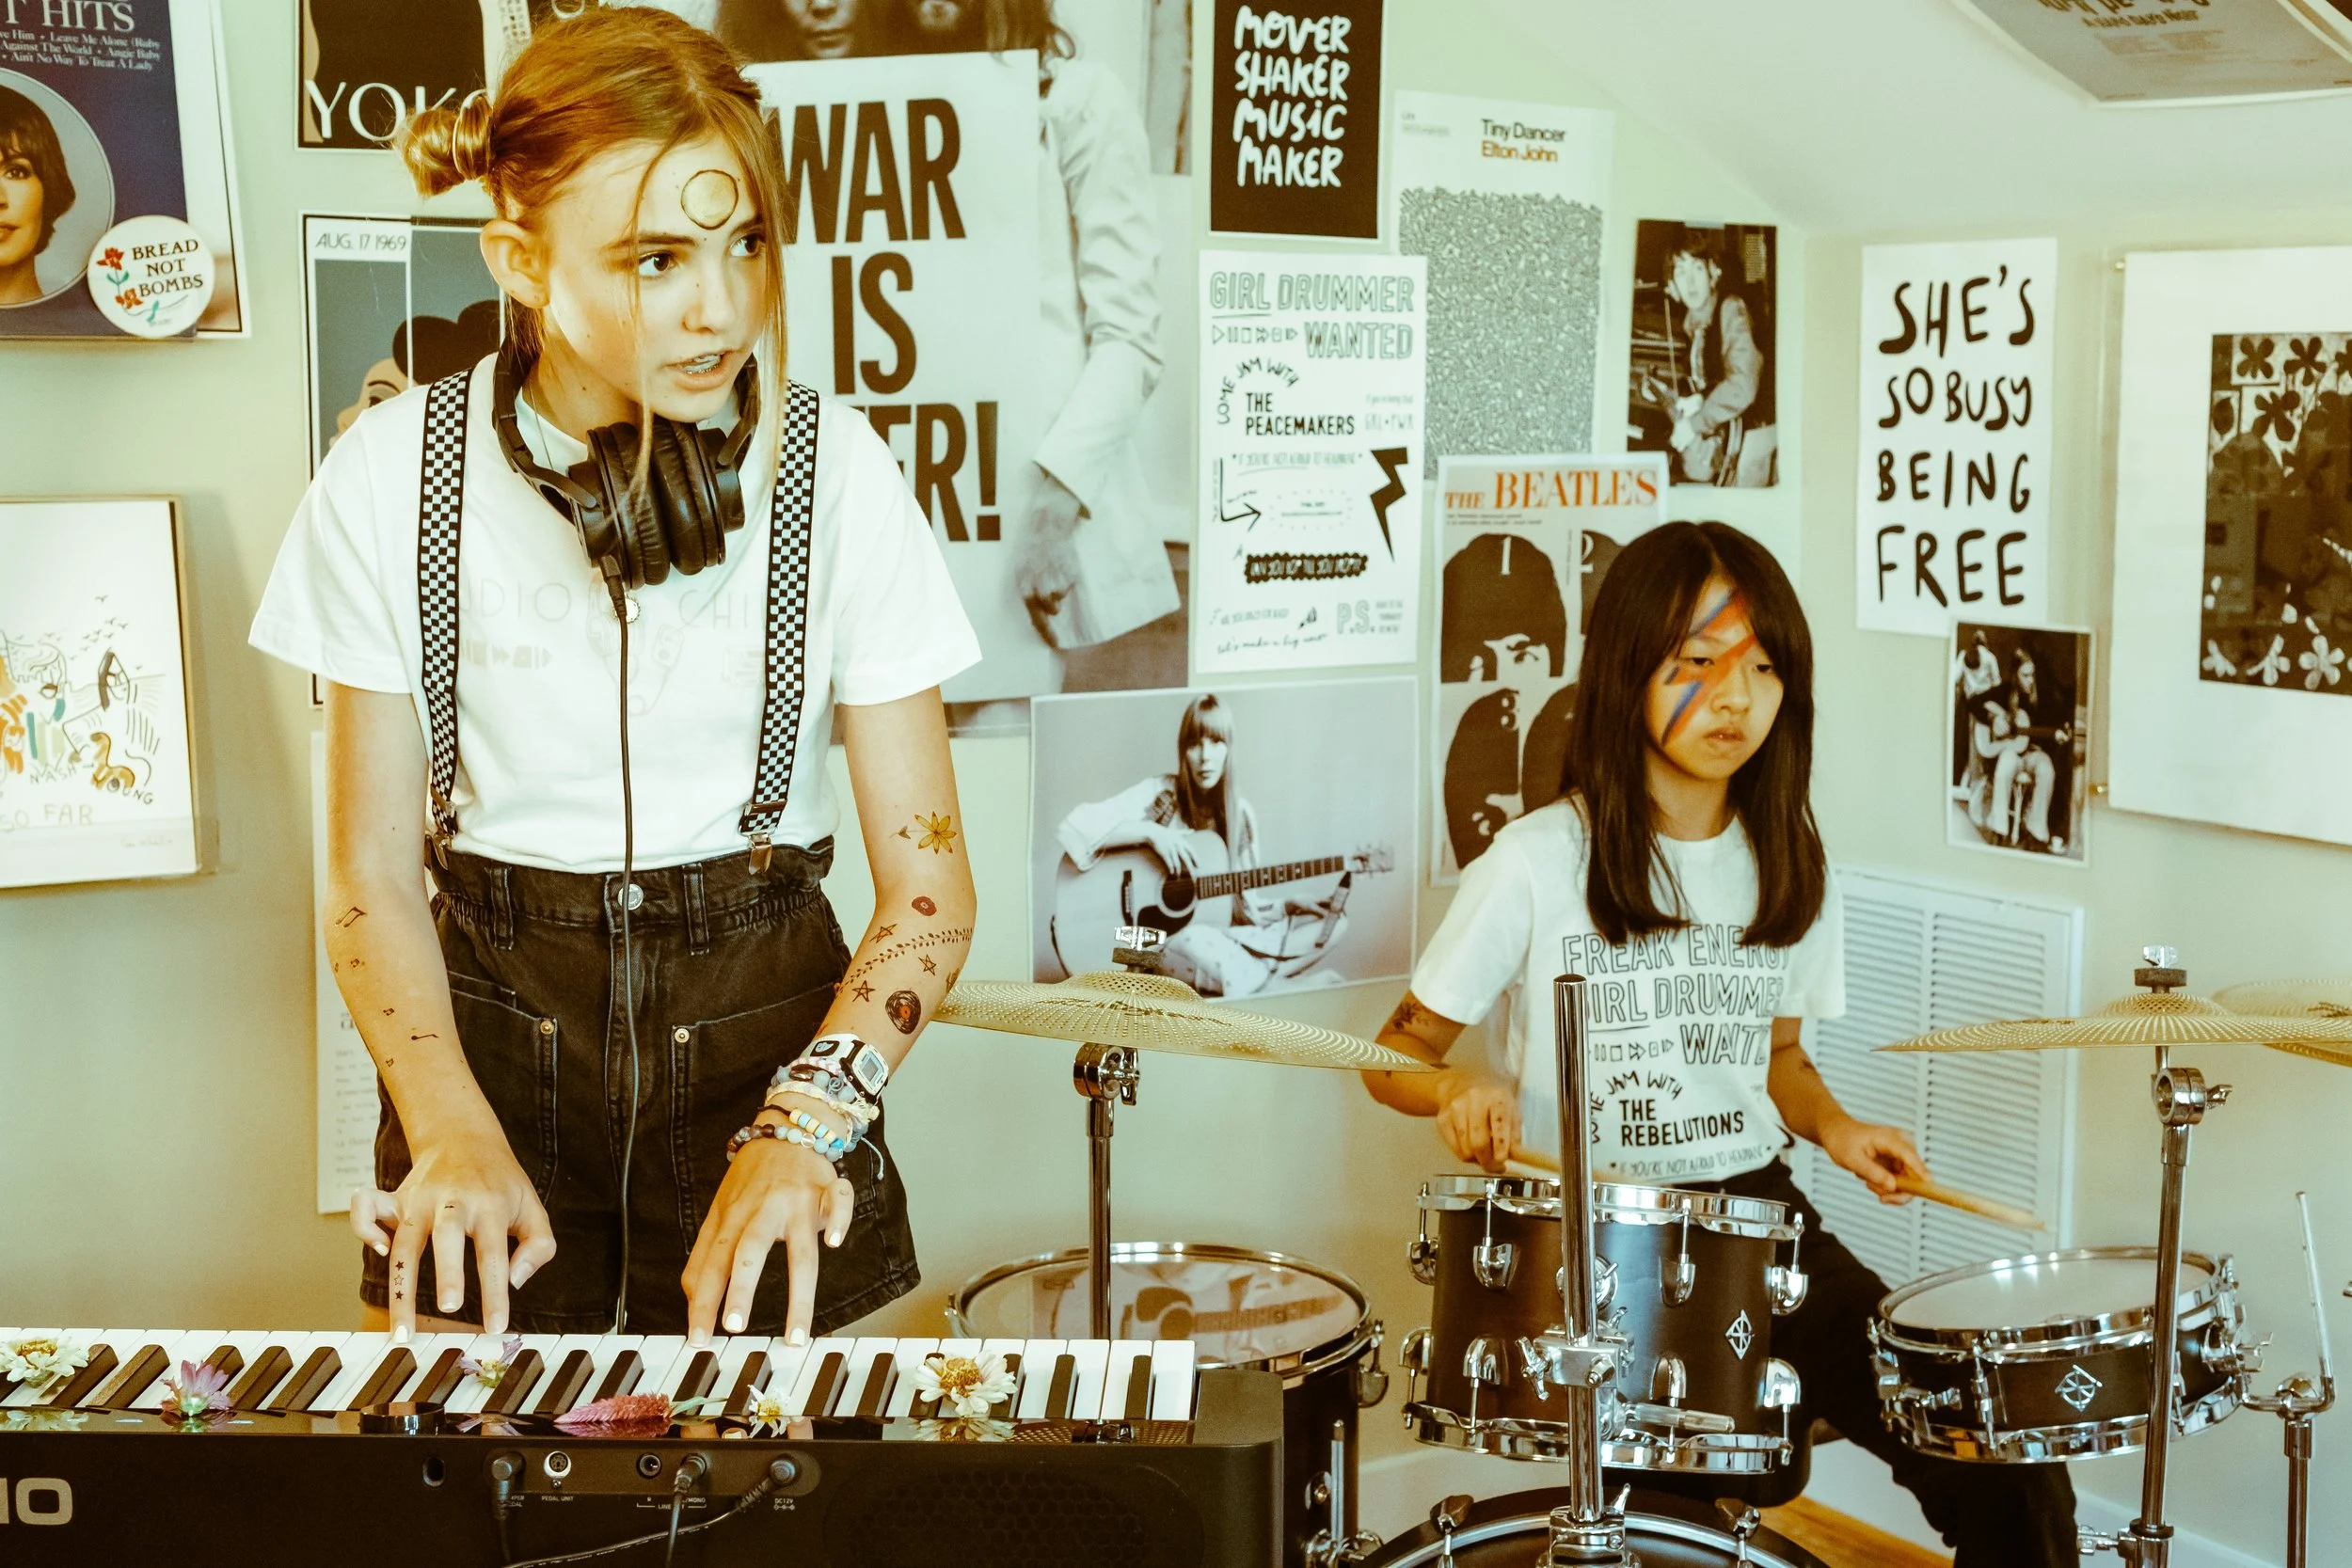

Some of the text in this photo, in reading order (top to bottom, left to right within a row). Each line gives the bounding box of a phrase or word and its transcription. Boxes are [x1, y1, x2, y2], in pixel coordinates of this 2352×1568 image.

[41, 0, 135, 32] HITS
[1234, 5, 1352, 55] MOVER
[1234, 50, 1351, 102] SHAKER
[305, 79, 486, 142] YOK
[1481, 118, 1511, 141] Tiny
[766, 98, 966, 245] WAR
[1236, 135, 1344, 188] MAKER
[1521, 143, 1560, 162] John
[132, 239, 199, 261] BREAD
[315, 232, 353, 250] AUG.
[374, 234, 407, 251] 1969
[138, 275, 204, 297] BOMBS
[146, 258, 186, 277] NOT
[1209, 271, 1414, 312] GIRL DRUMMER
[1879, 264, 2035, 358] SHE'S
[832, 251, 916, 395] IS
[1304, 321, 1414, 359] WANTED
[1245, 391, 1273, 413] THE
[1879, 366, 2032, 431] SO BUSY
[1246, 415, 1355, 436] PEACEMAKERS
[1445, 468, 1658, 509] THE BEATLES
[1877, 450, 2030, 514] BEING
[1877, 525, 2027, 608] FREE
[44, 803, 93, 827] FAR
[1563, 926, 1674, 975] FREAK
[1587, 980, 1648, 1023] IRL
[1605, 1069, 1640, 1095] JAM
[1646, 1069, 1683, 1101] WITH
[1619, 1099, 1656, 1122] THE
[1621, 1110, 1744, 1148] REBELUTIONS
